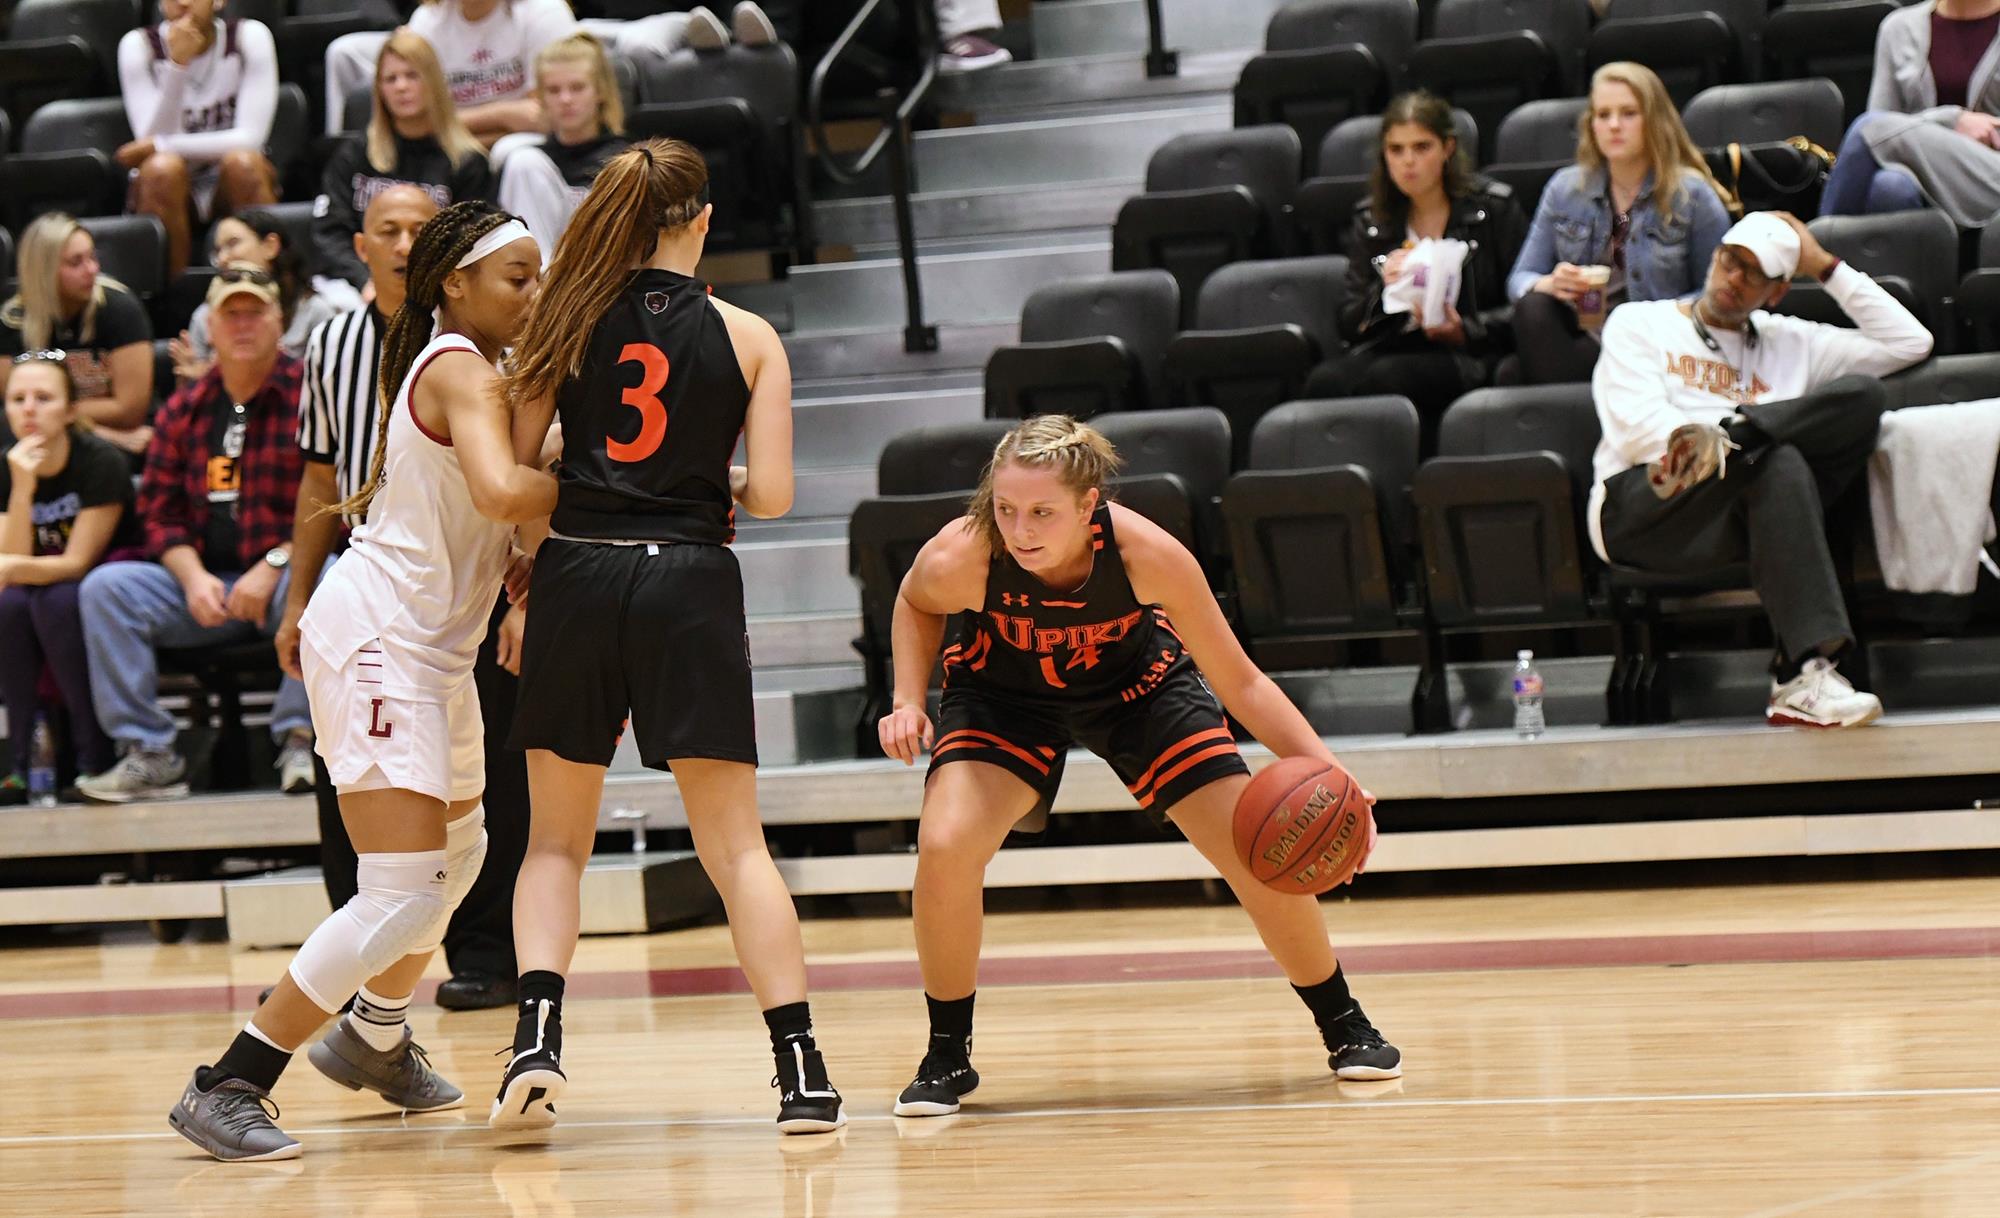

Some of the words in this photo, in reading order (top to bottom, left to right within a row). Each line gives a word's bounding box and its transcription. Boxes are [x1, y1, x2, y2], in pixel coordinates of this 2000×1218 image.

[1664, 352, 1773, 397] LOYOA
[606, 342, 670, 462] 3
[1039, 645, 1103, 688] 14
[367, 697, 393, 739] L
[1263, 784, 1337, 869] SPALDING
